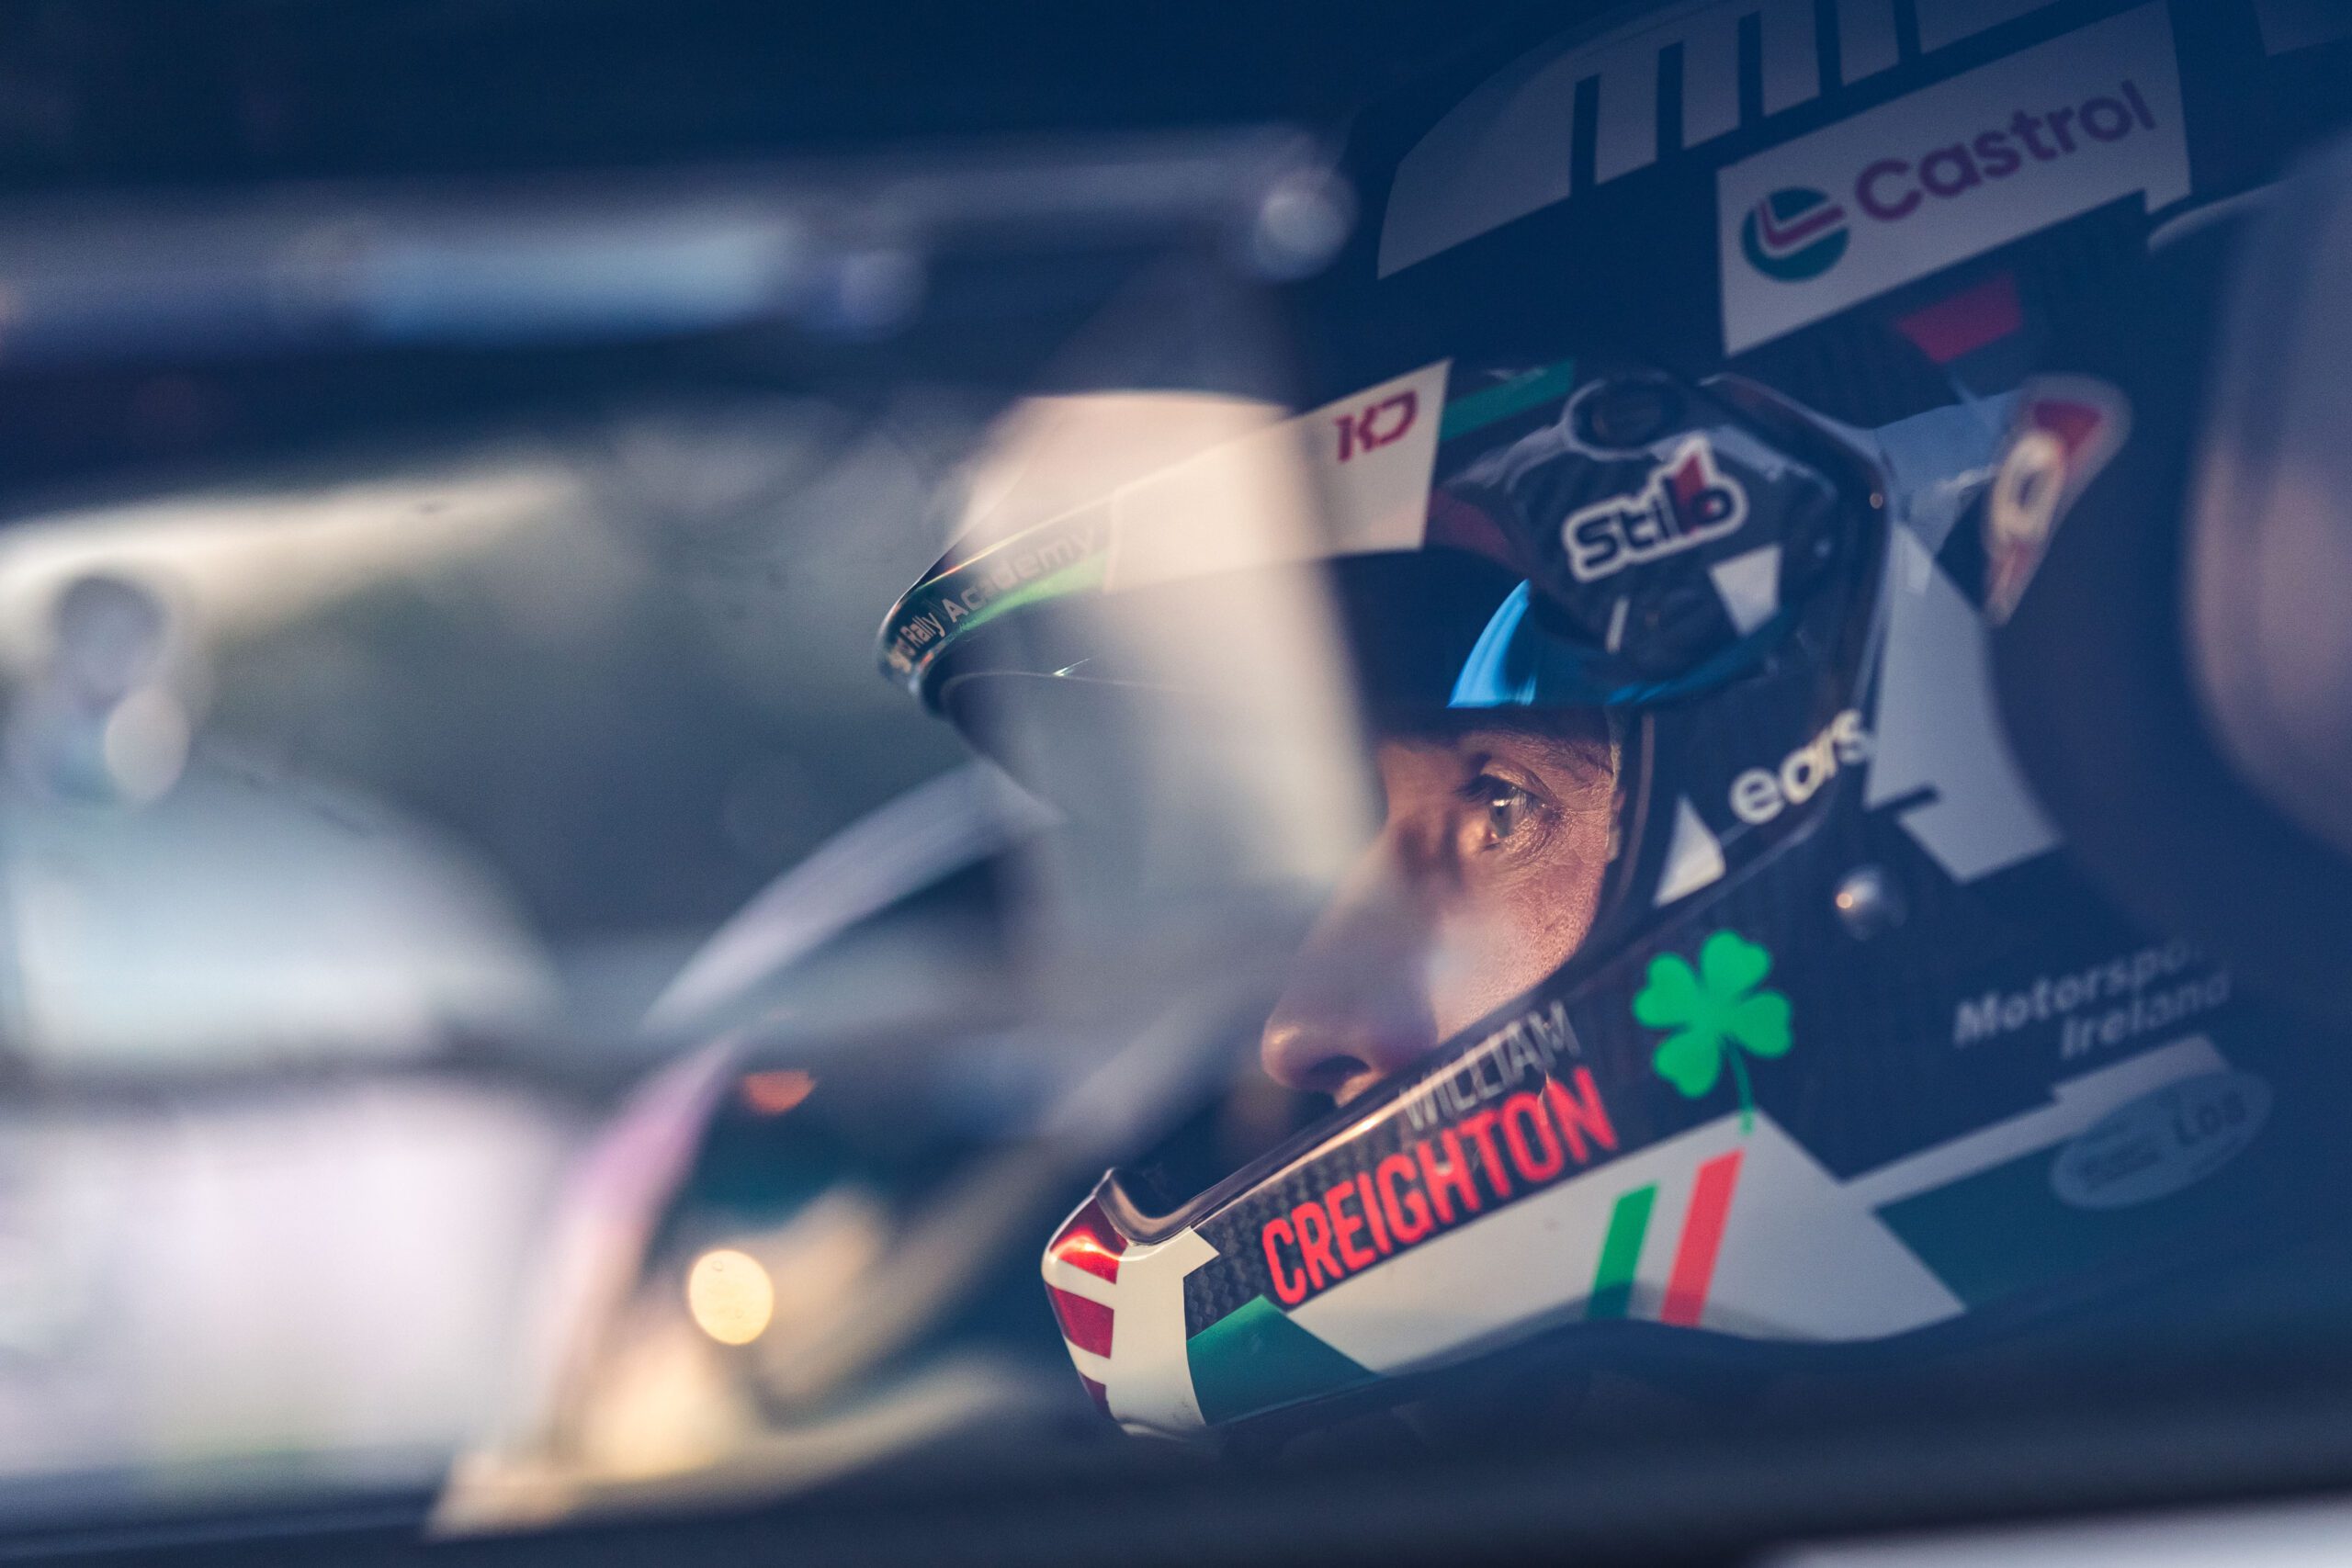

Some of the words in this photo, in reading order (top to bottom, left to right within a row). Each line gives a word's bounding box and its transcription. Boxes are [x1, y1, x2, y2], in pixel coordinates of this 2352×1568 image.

[1854, 80, 2154, 221] Castrol
[899, 613, 945, 649] Rally
[1952, 938, 2203, 1047] Motorspo
[2061, 966, 2232, 1059] Ireland
[1399, 1000, 1581, 1131] WILLIAM
[1261, 1066, 1617, 1305] CREIGHTON
